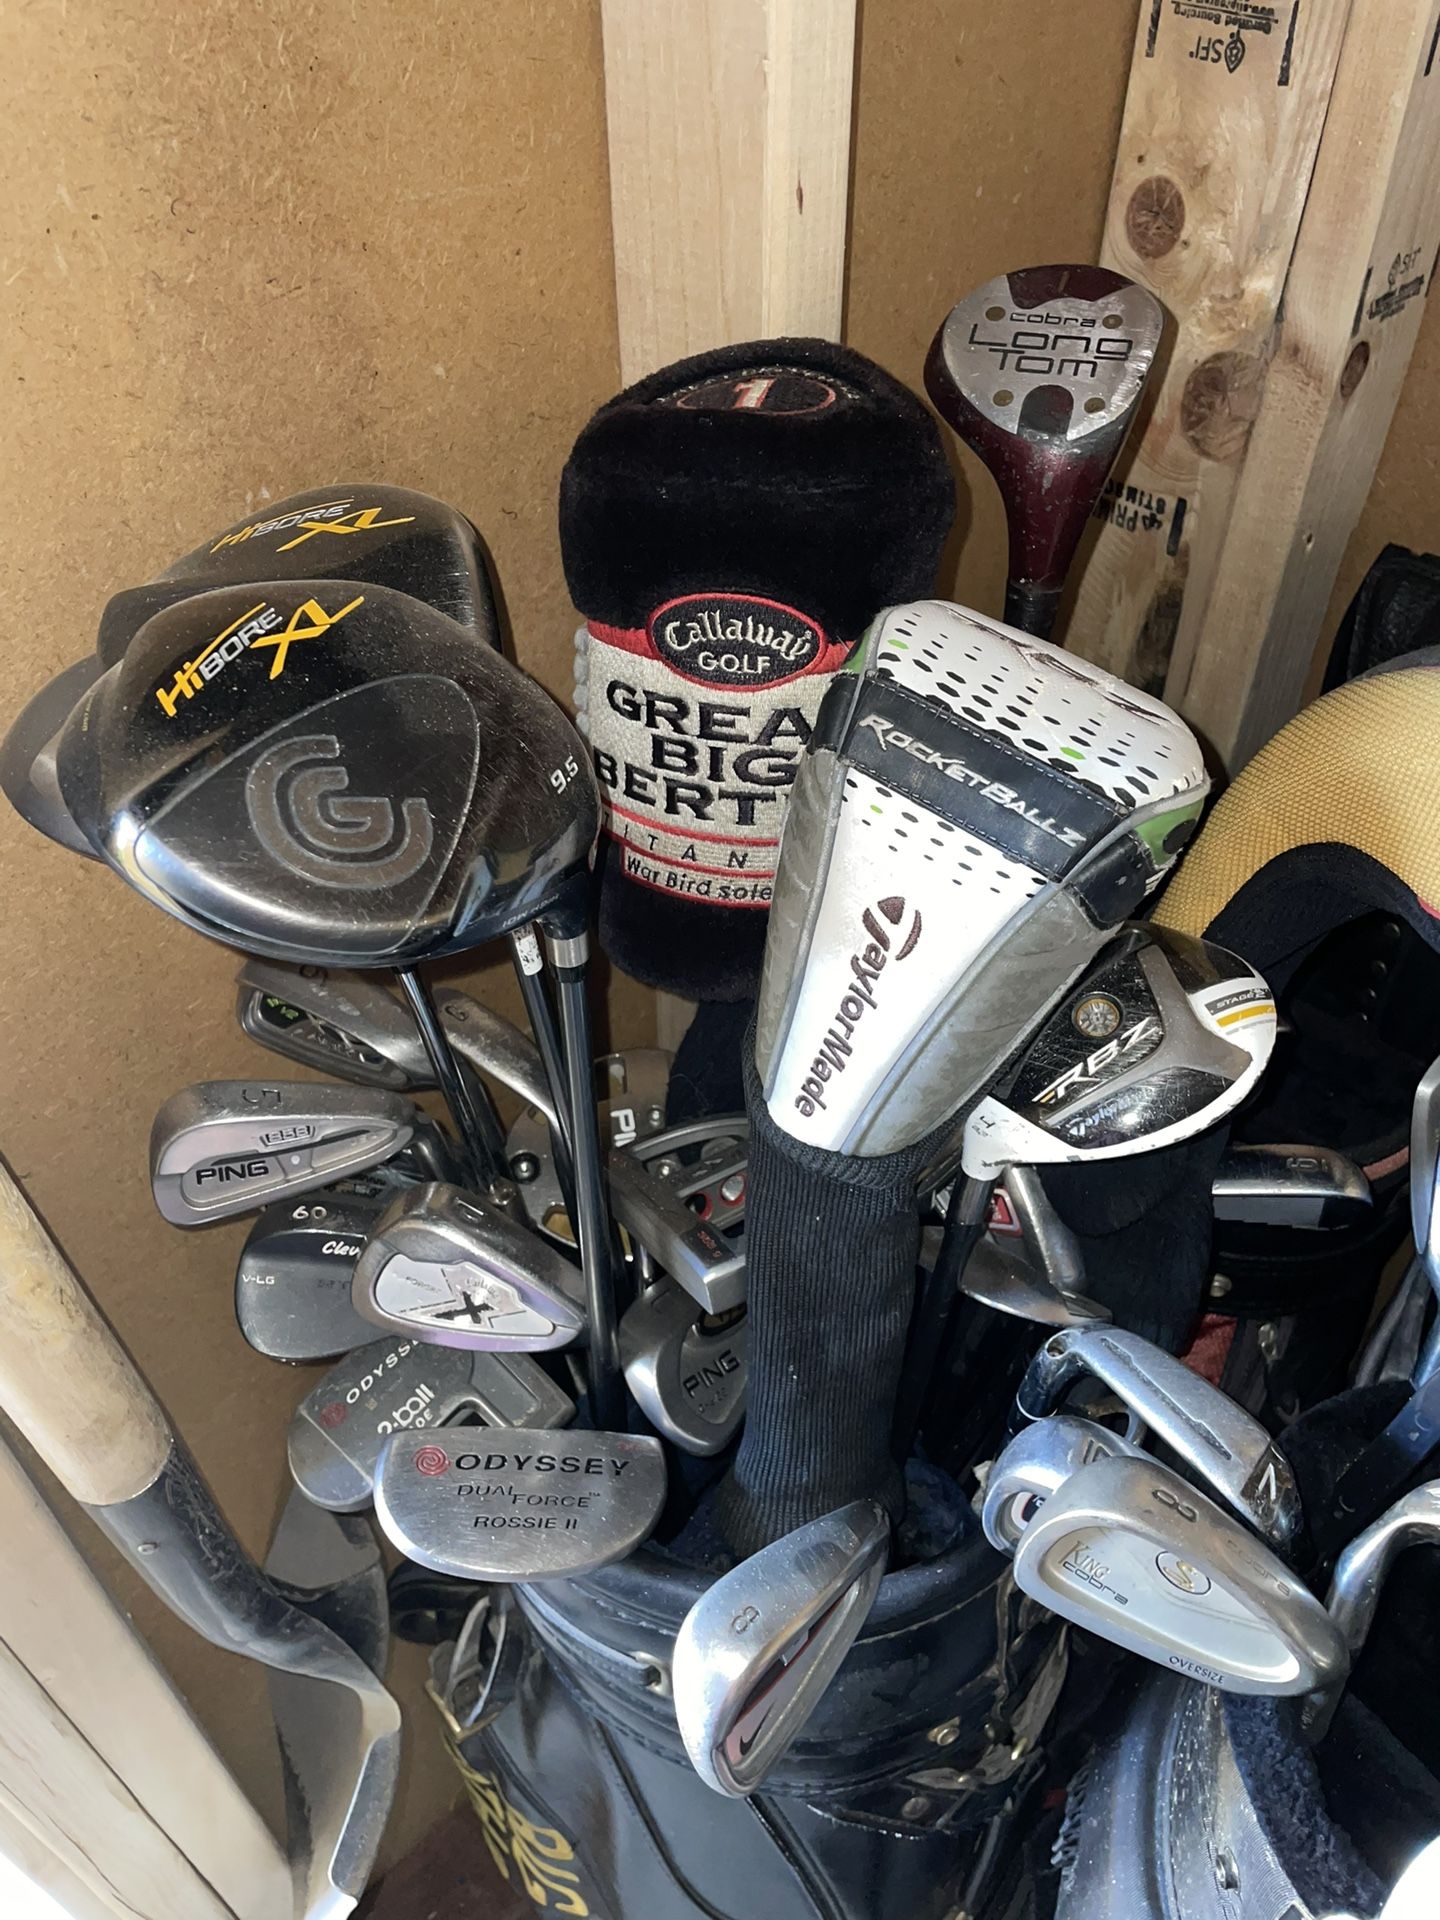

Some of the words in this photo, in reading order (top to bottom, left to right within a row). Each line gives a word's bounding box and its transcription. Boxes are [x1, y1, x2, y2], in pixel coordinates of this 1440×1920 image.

[1009, 312, 1097, 329] cobra
[664, 609, 814, 661] Callaway
[697, 650, 772, 675] GOLF
[605, 678, 815, 746] GREA
[550, 755, 580, 795] 9.5
[651, 733, 803, 786] BIG
[592, 745, 795, 826] BERT
[626, 854, 661, 883] War
[664, 863, 713, 897] Bird
[195, 1160, 270, 1186] PING
[292, 1205, 328, 1220] 60
[321, 1240, 361, 1258] Clev
[241, 1273, 276, 1286] V-LG
[682, 1348, 740, 1399] PING
[455, 1453, 630, 1477] ODYSSEY
[1152, 1487, 1198, 1524] 8
[472, 1515, 558, 1530] ROSSIE
[1061, 1560, 1130, 1607] cobra
[731, 1605, 761, 1636] 8
[1168, 1655, 1226, 1686] OVERSIZE
